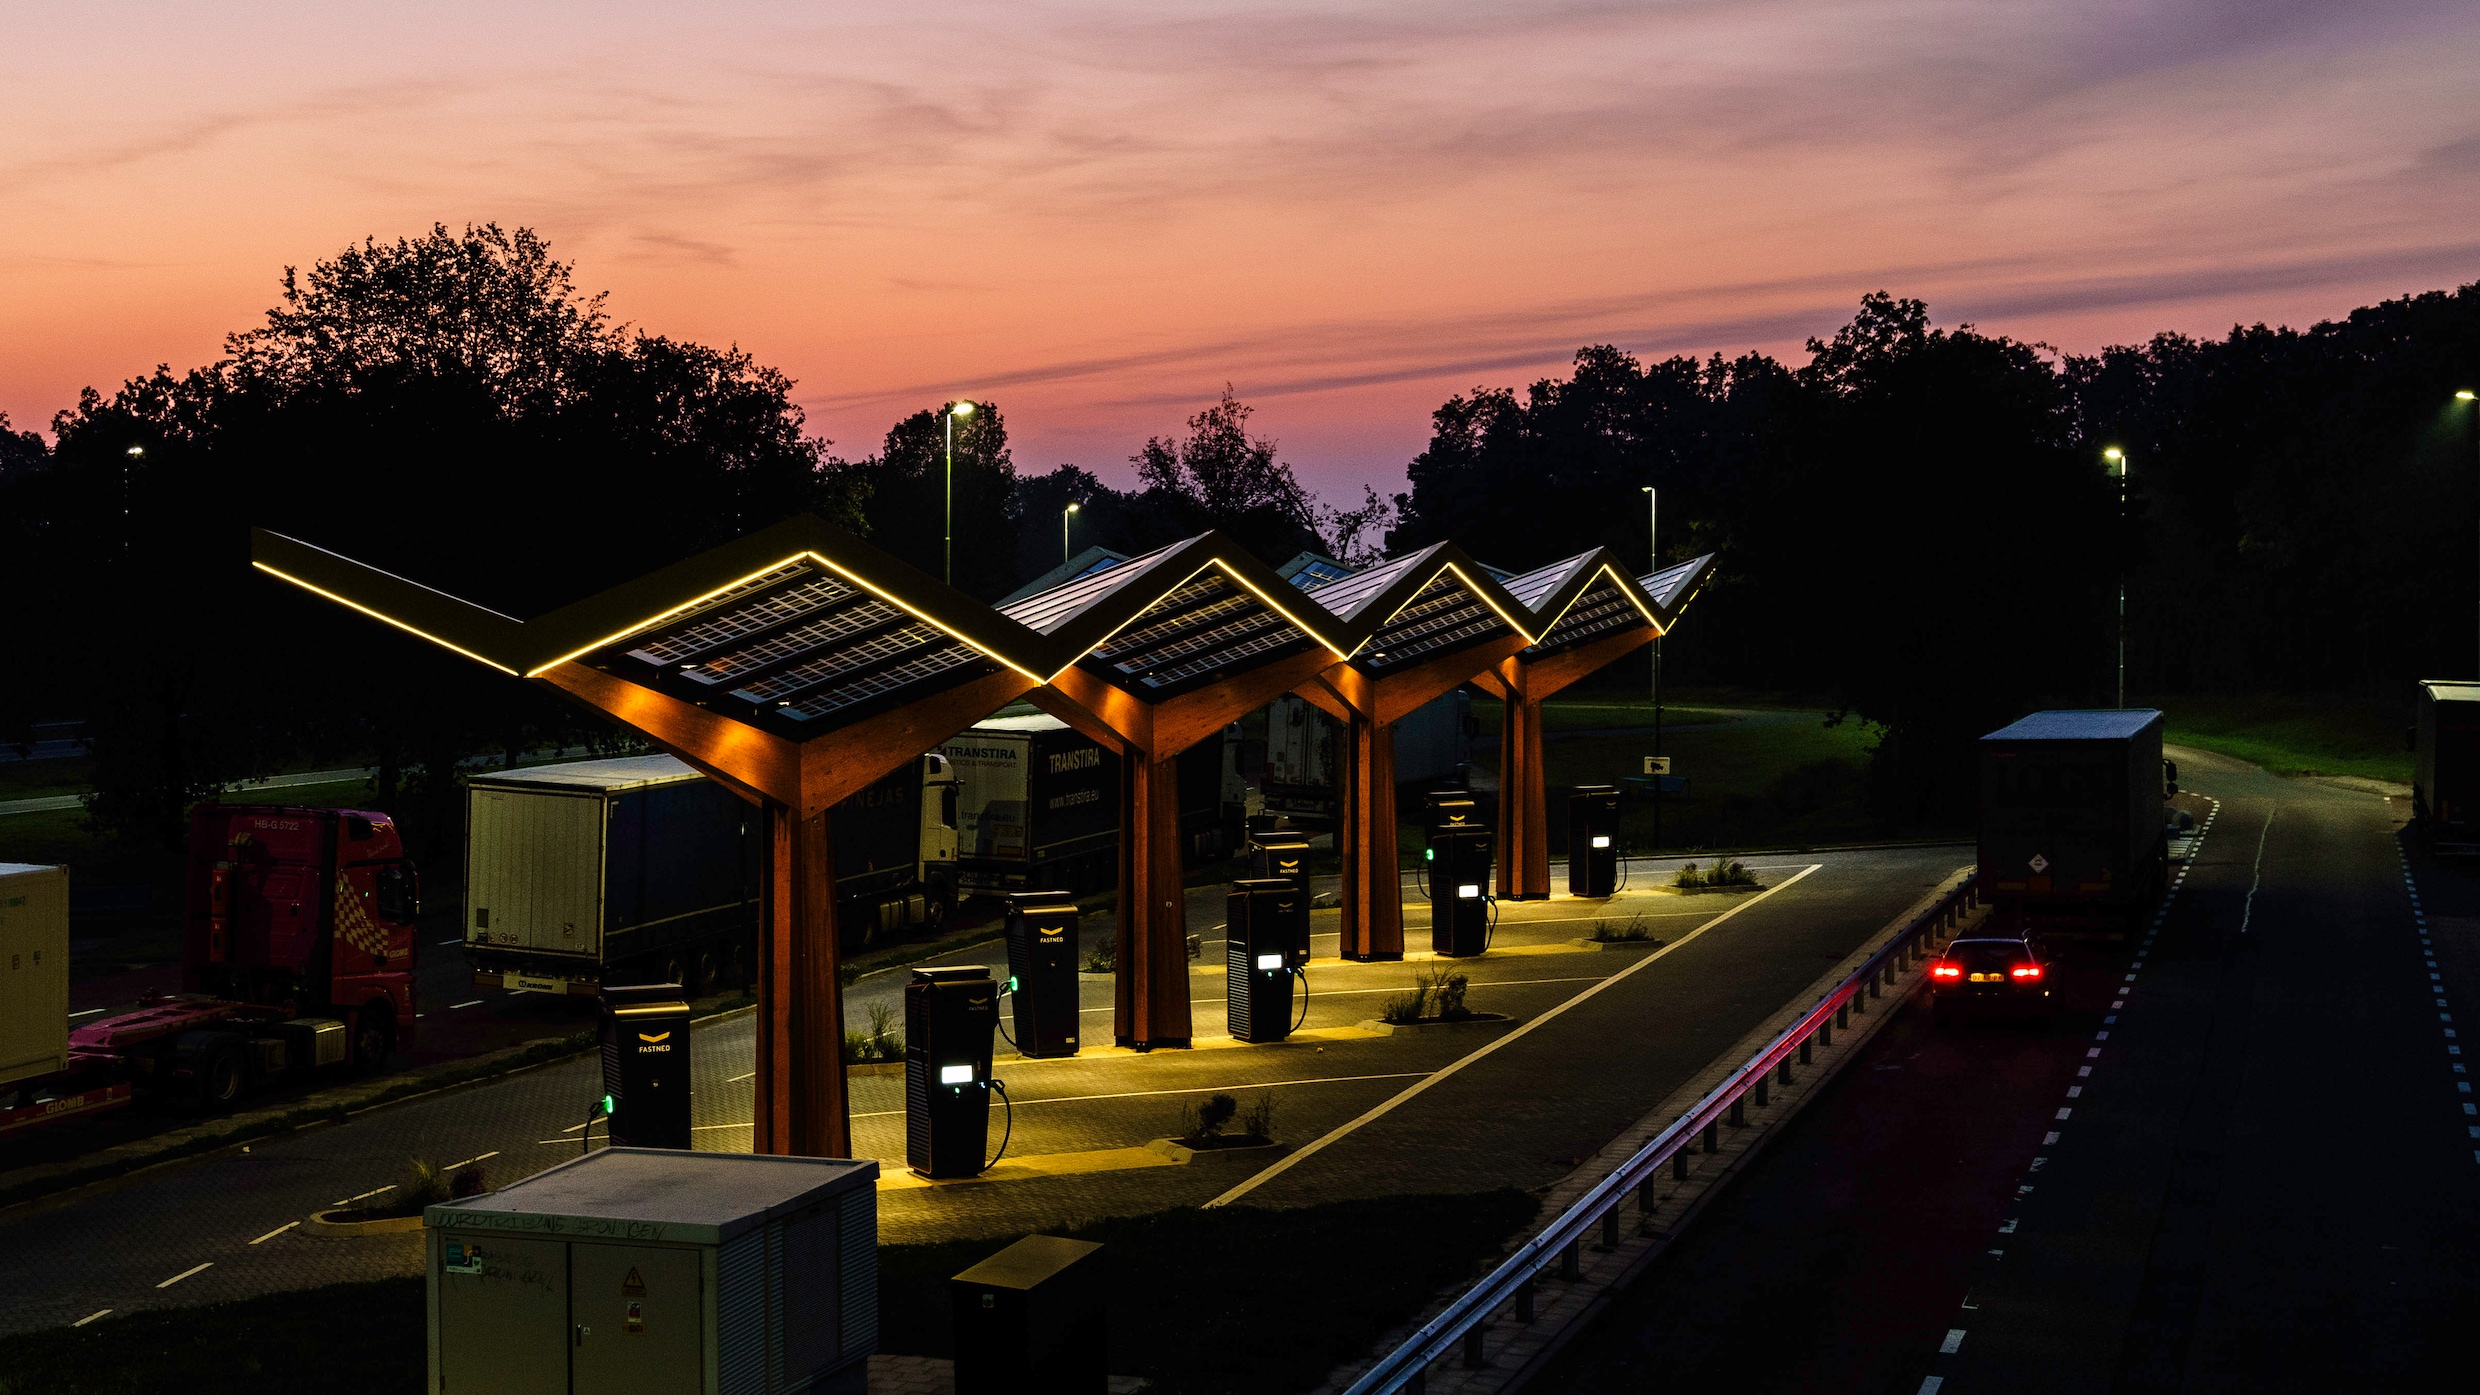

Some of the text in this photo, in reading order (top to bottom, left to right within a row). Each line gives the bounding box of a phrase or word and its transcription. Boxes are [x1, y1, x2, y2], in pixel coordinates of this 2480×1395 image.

[948, 747, 1017, 760] TRANSTIRA
[978, 760, 1017, 769] TRANSPORT
[1049, 748, 1100, 775] TRANSTIRA
[1050, 788, 1100, 810] www.transtira.eu
[959, 810, 1016, 822] .transtira.eu
[254, 819, 300, 831] HB-G 5722
[1039, 936, 1064, 944] FASTNED
[638, 1044, 671, 1054] FASTNED
[45, 1095, 85, 1115] GLOMB
